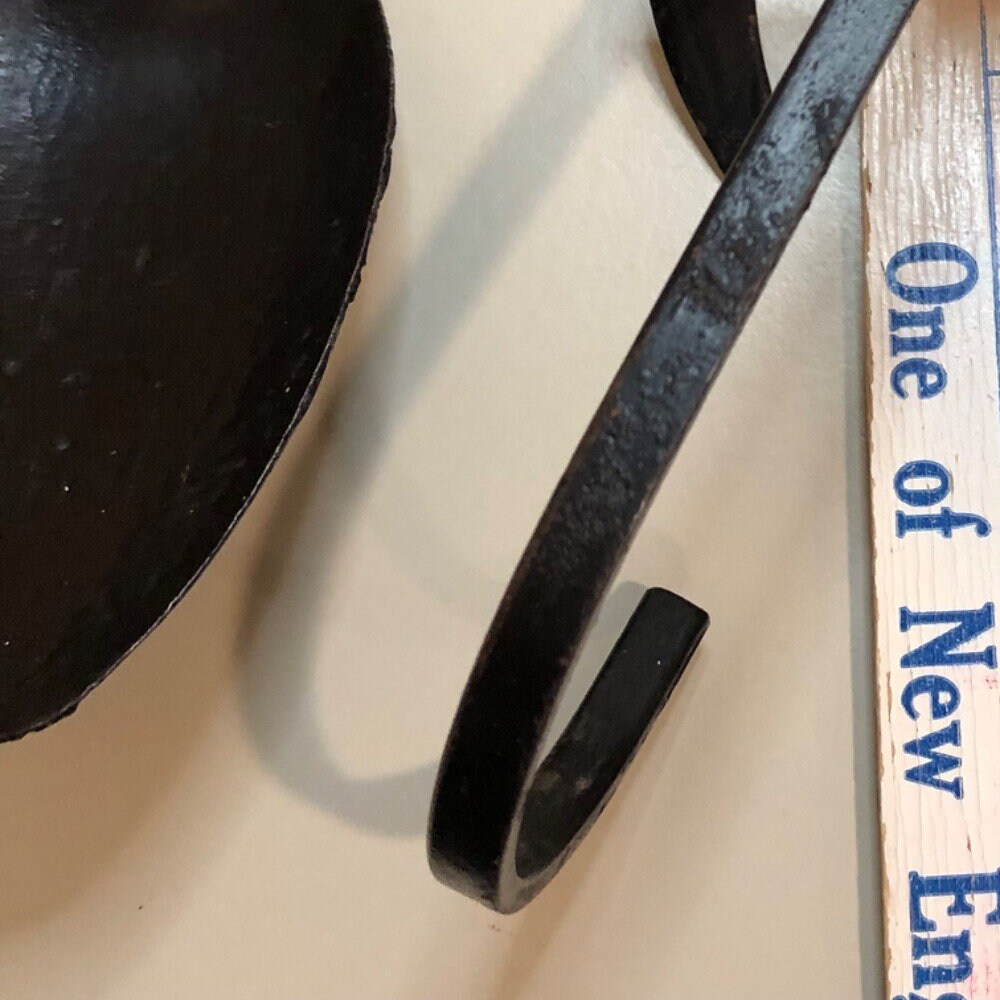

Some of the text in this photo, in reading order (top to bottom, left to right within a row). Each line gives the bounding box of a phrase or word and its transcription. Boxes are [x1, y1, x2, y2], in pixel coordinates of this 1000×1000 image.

[885, 241, 979, 400] One
[892, 459, 992, 539] of
[899, 601, 998, 801] New
